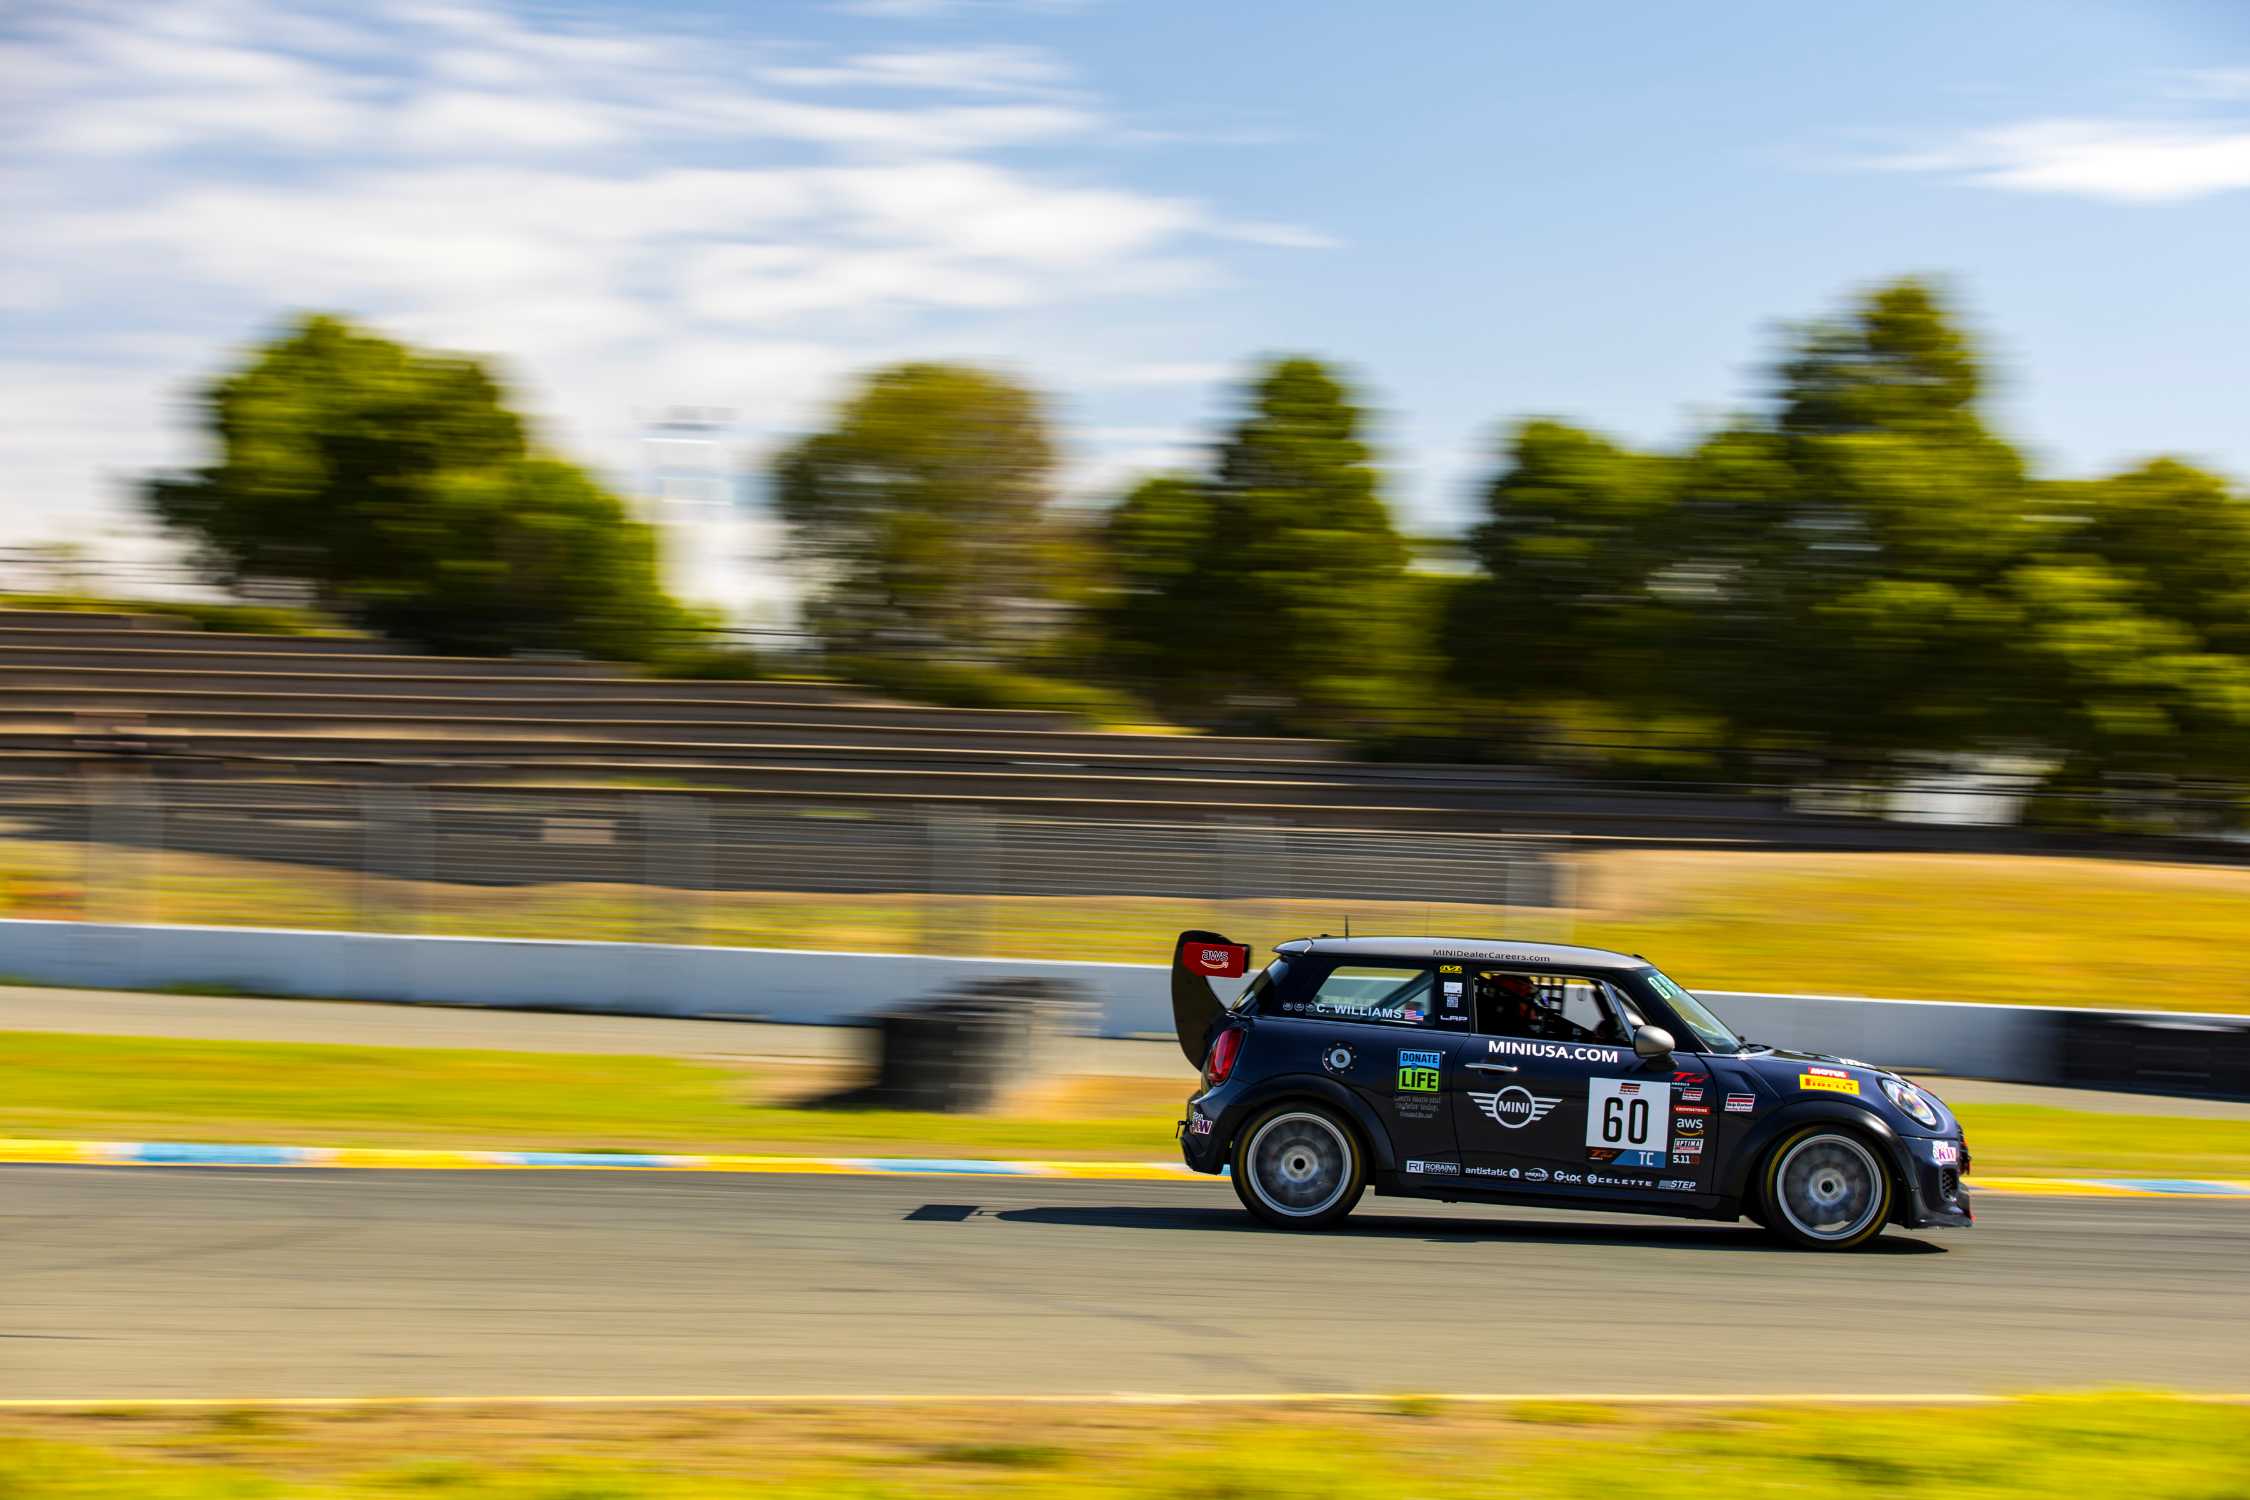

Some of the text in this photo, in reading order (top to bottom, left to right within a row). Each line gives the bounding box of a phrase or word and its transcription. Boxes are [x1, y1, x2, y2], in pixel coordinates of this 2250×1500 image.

[1202, 950, 1229, 961] aws
[1432, 949, 1551, 963] MINIDealerCareers.com
[1316, 1003, 1402, 1018] C. WILLIAMS
[1488, 1040, 1618, 1063] MINIUSA.COM
[1402, 1052, 1438, 1063] DONATE
[1402, 1070, 1437, 1088] LIFE
[1499, 1101, 1530, 1114] MINI
[1602, 1097, 1649, 1144] 60
[1676, 1118, 1703, 1129] aws
[1638, 1151, 1654, 1165] TC
[1673, 1155, 1690, 1164] 5.11
[1425, 1163, 1457, 1171] ROBAINA
[1465, 1167, 1508, 1177] antistatic
[1598, 1177, 1653, 1187] CELETTE
[1670, 1180, 1696, 1189] STEP
